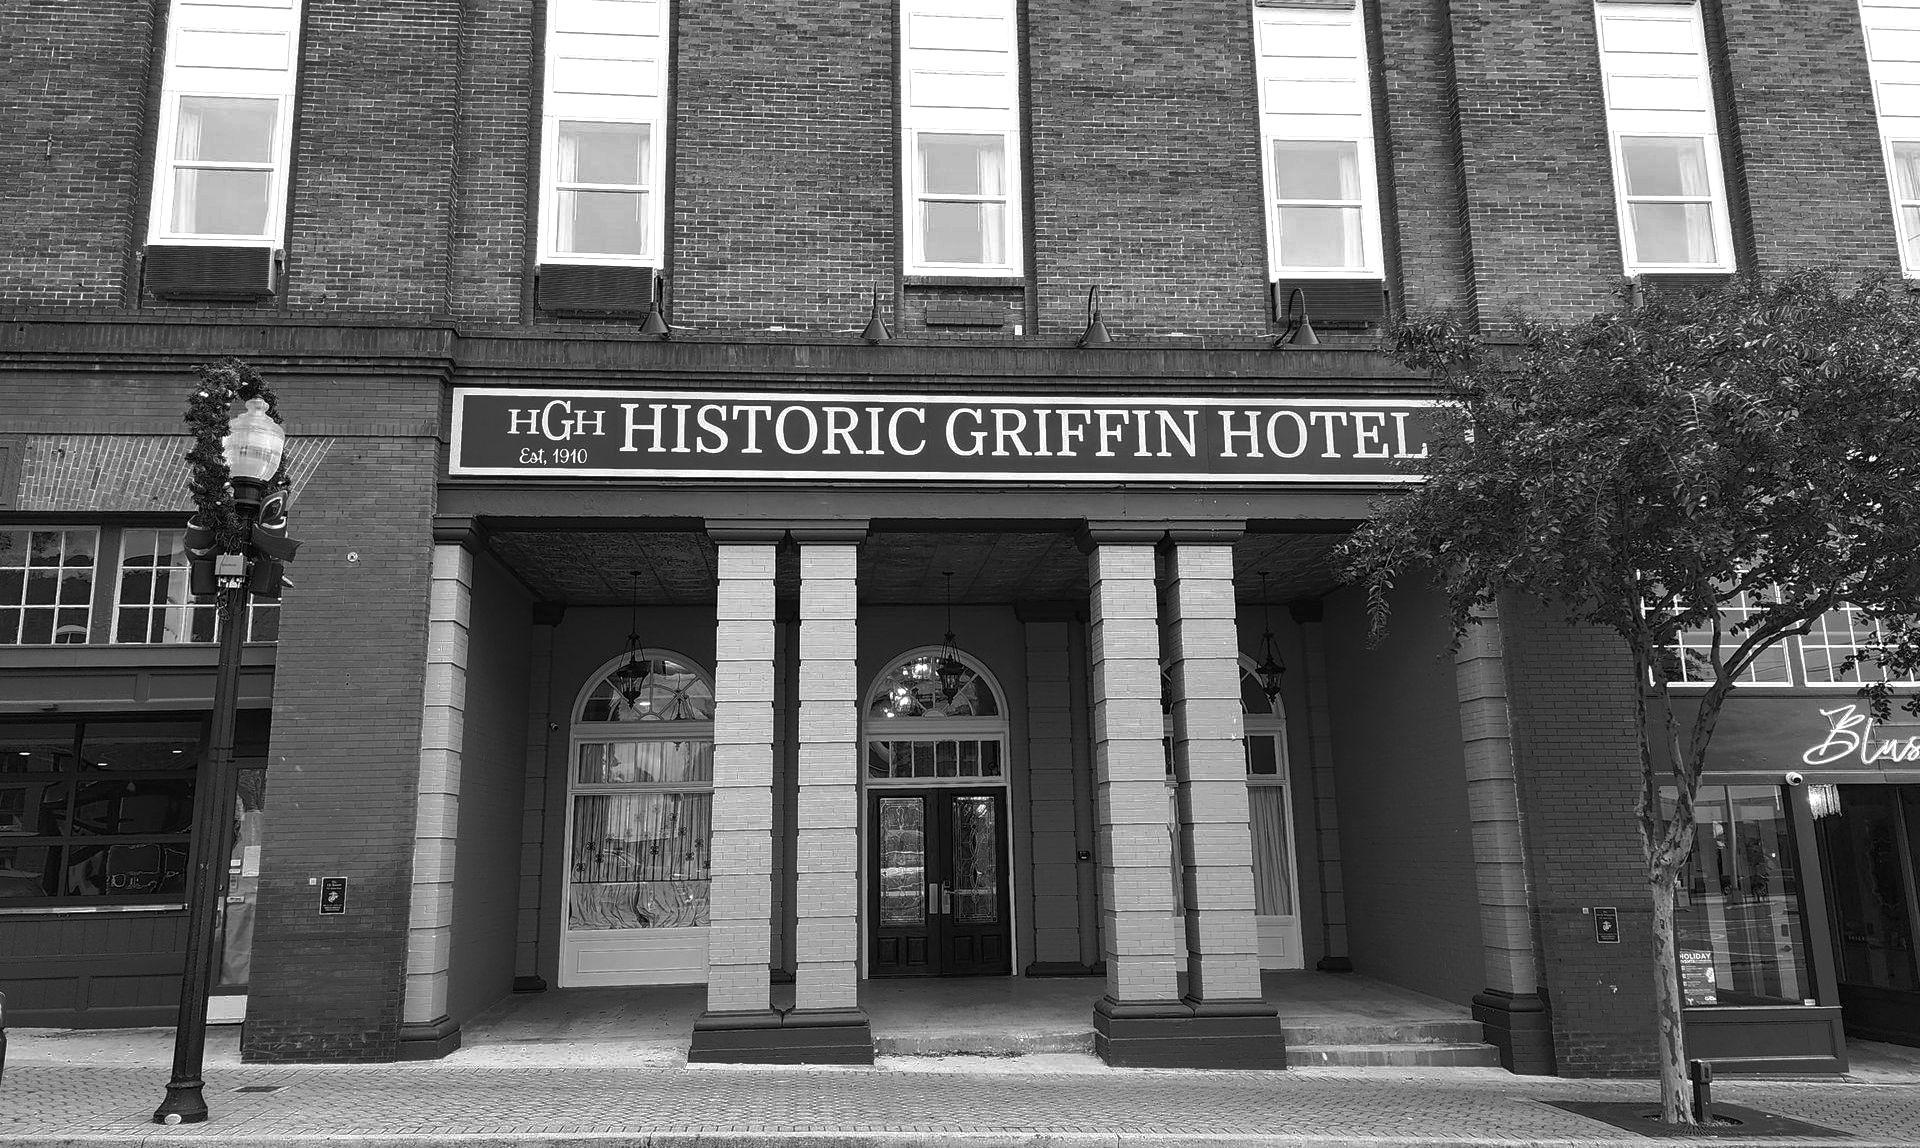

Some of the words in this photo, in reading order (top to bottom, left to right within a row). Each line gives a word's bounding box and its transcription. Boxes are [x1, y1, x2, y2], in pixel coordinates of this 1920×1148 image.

[507, 400, 606, 440] HGH
[619, 402, 927, 456] HISTORIC
[945, 407, 1199, 458] GRIFFIN
[1217, 410, 1429, 459] HOTEL
[552, 448, 588, 464] 1910
